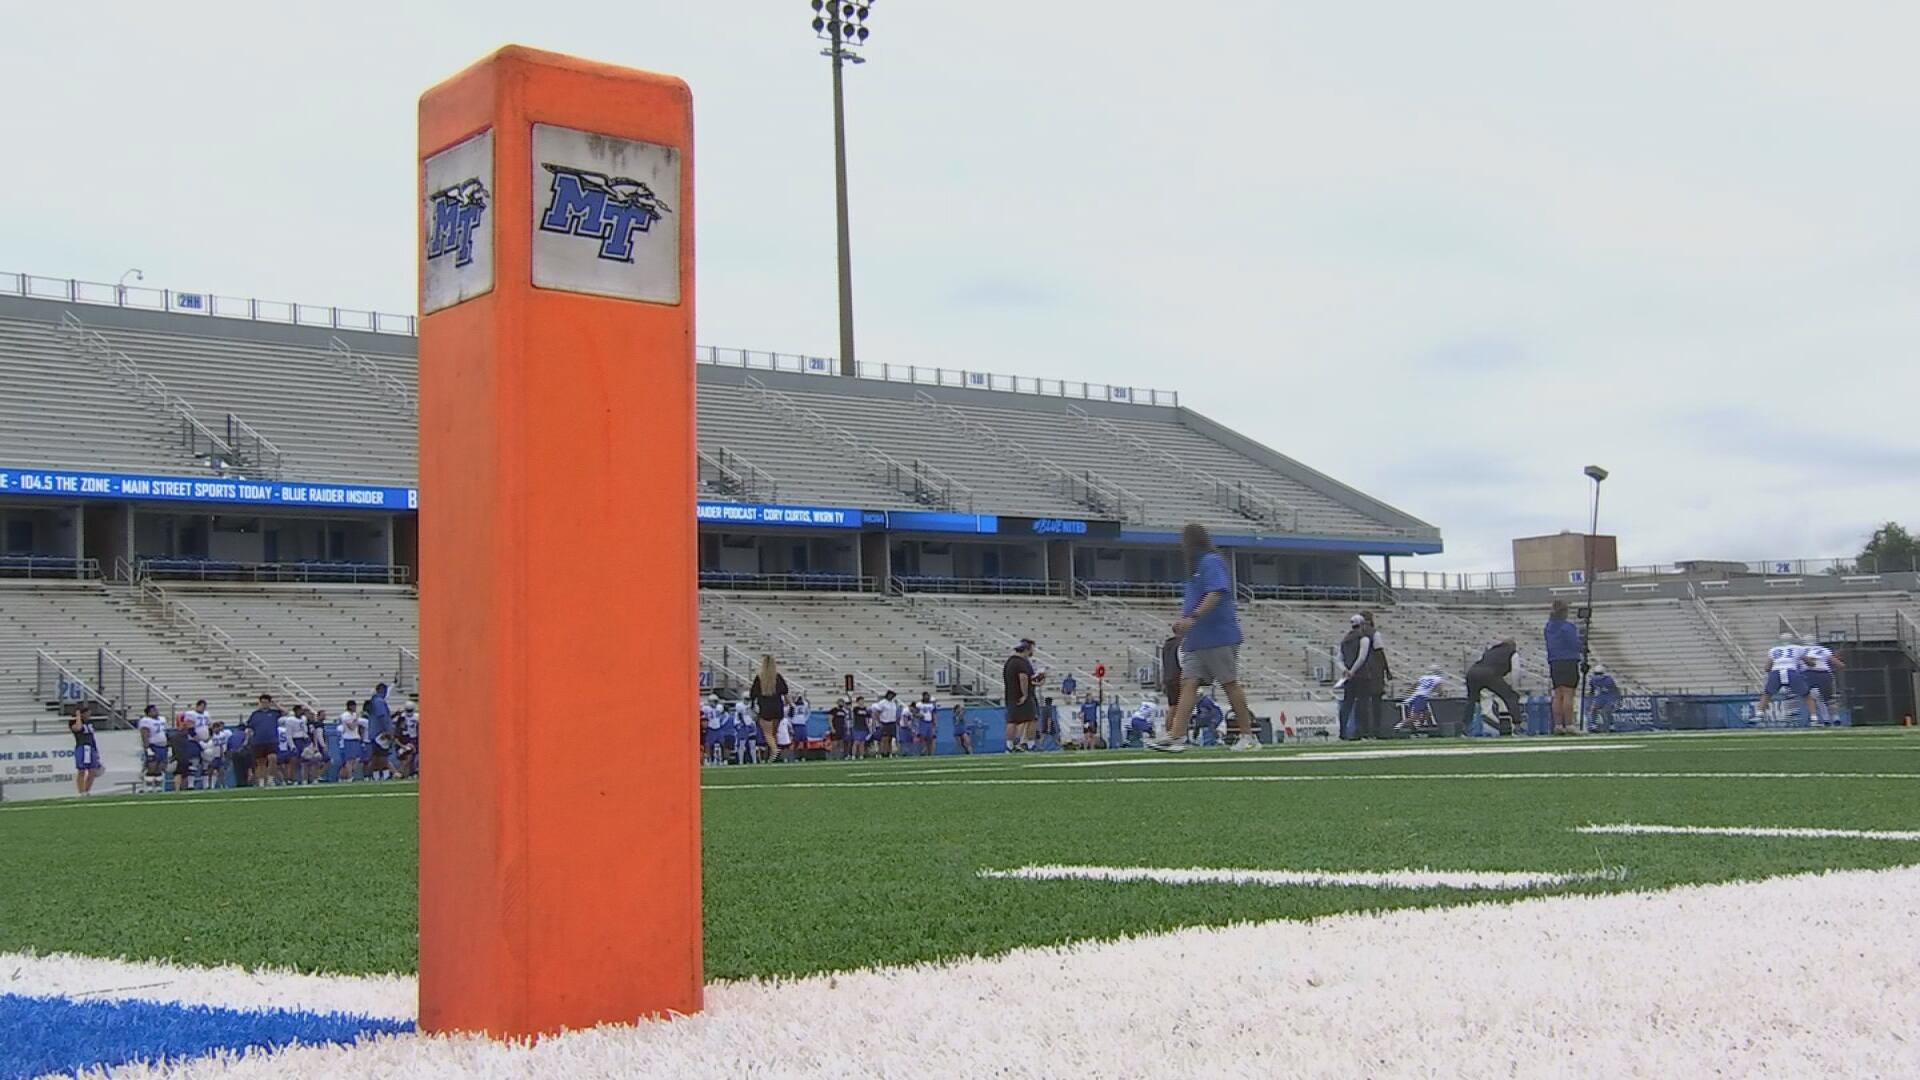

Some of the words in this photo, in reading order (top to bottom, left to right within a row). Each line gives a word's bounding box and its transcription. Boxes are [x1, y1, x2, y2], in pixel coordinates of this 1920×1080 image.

[428, 196, 482, 268] MT
[539, 171, 654, 265] MT
[20, 474, 53, 490] 104.5
[55, 476, 78, 491] THE
[80, 477, 111, 493] ZONE
[121, 479, 150, 494] MAIN
[152, 481, 192, 497] STREET
[194, 483, 236, 498] SPORTS
[238, 484, 273, 500] TODAY
[281, 487, 307, 502] BLUE
[309, 488, 345, 503] RAIDER
[346, 490, 384, 505] INSIDER
[723, 506, 757, 520] PODCAST
[763, 508, 784, 521] CORY
[835, 511, 845, 524] TV
[18, 750, 49, 761] BRAA
